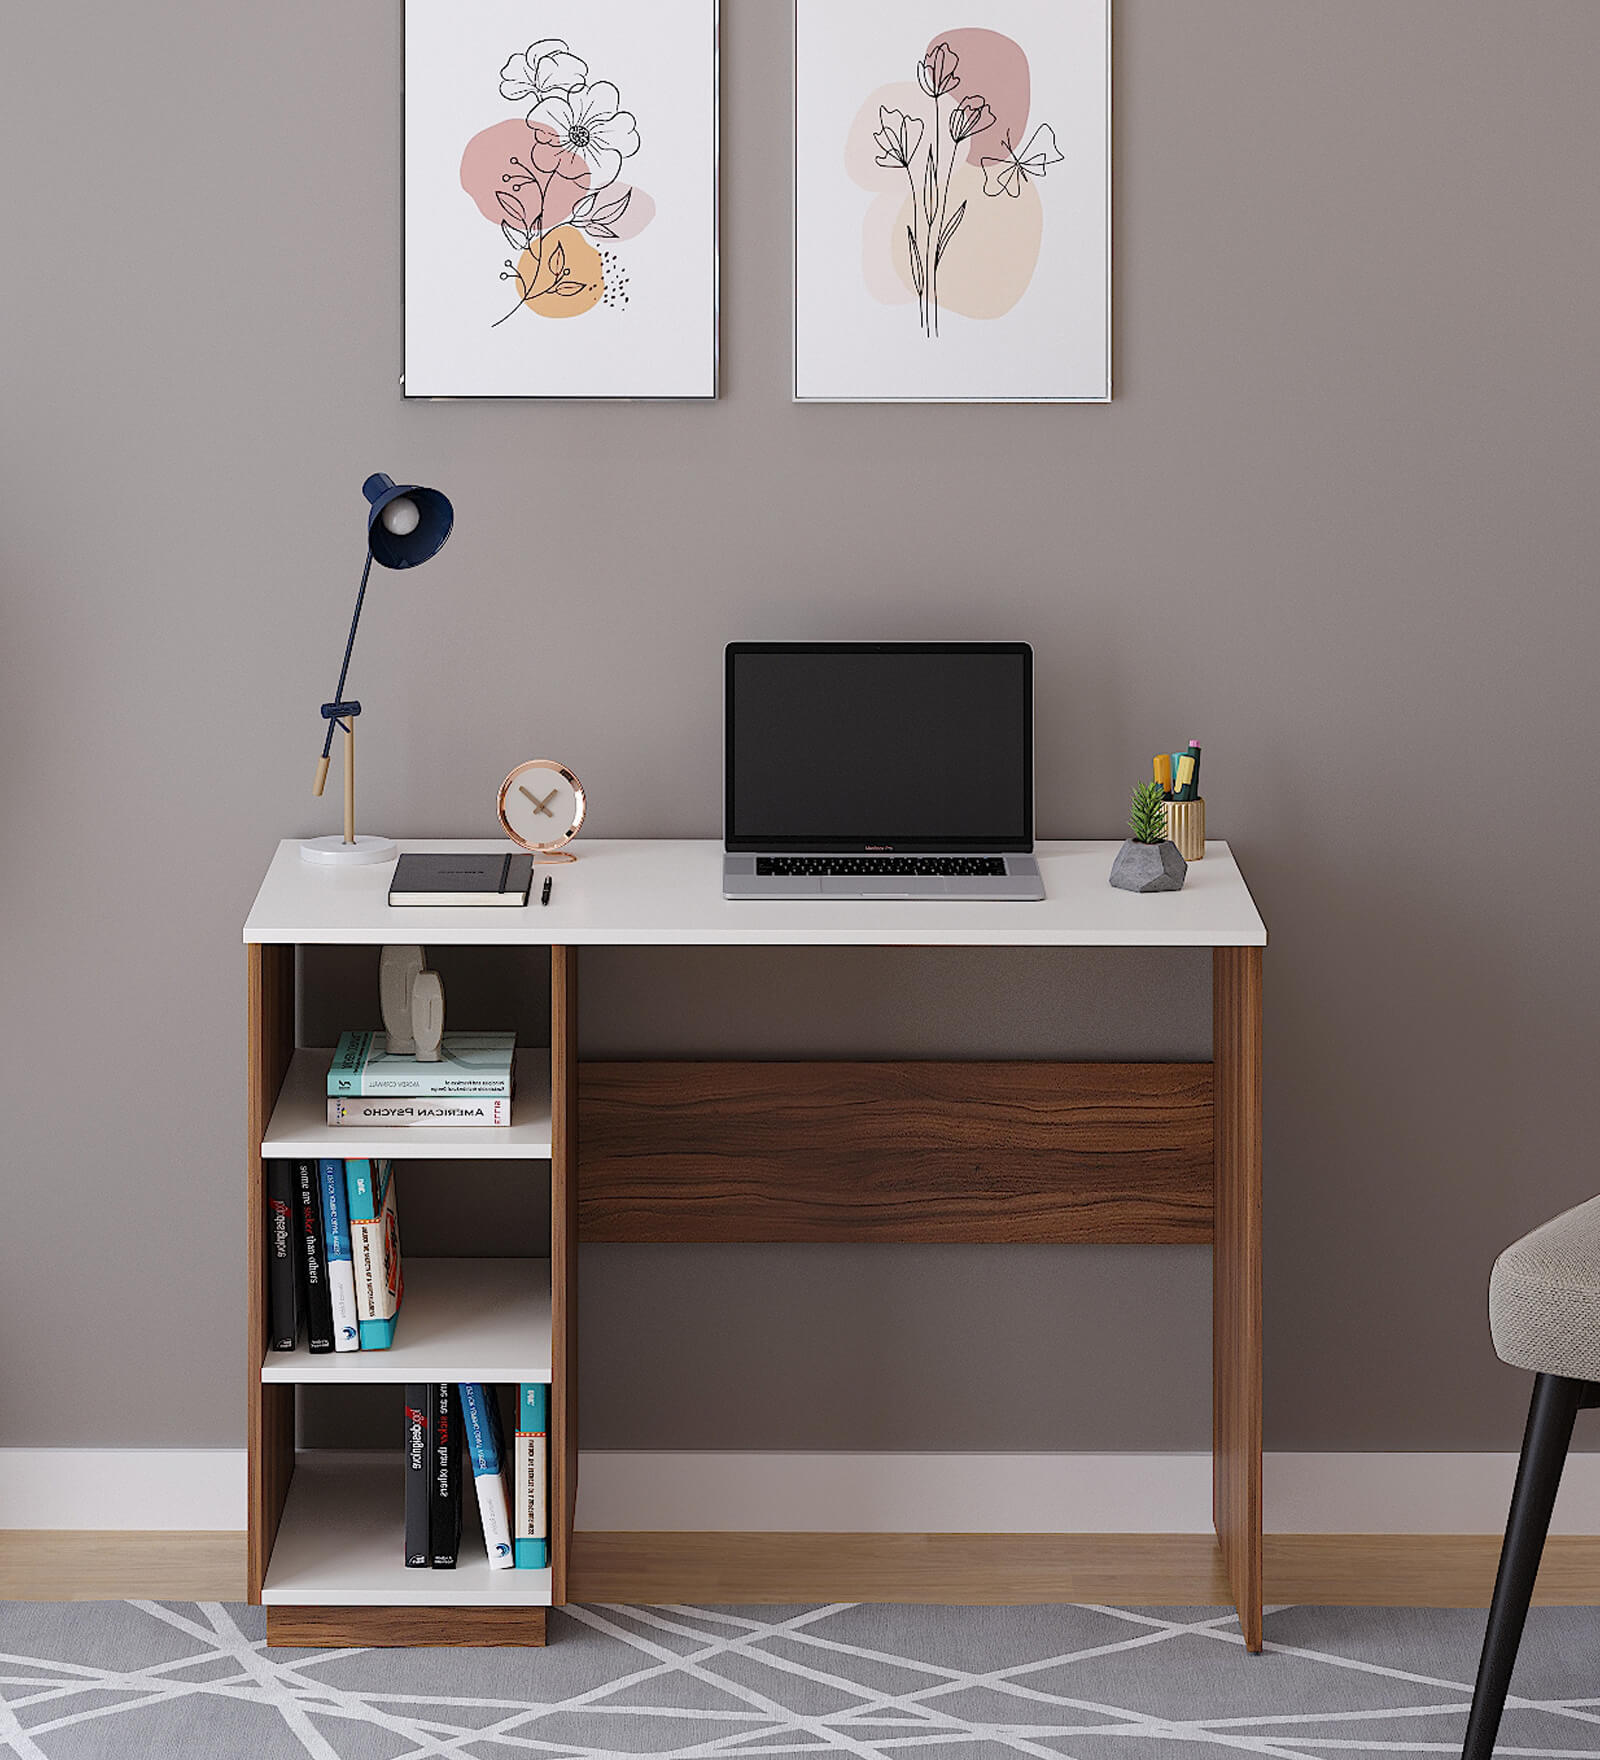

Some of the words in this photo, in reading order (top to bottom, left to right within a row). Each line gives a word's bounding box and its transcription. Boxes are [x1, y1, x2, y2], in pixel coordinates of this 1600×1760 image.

[300, 1165, 309, 1189] some
[302, 1191, 311, 1205] are
[306, 1235, 316, 1257] than
[308, 1256, 319, 1284] others
